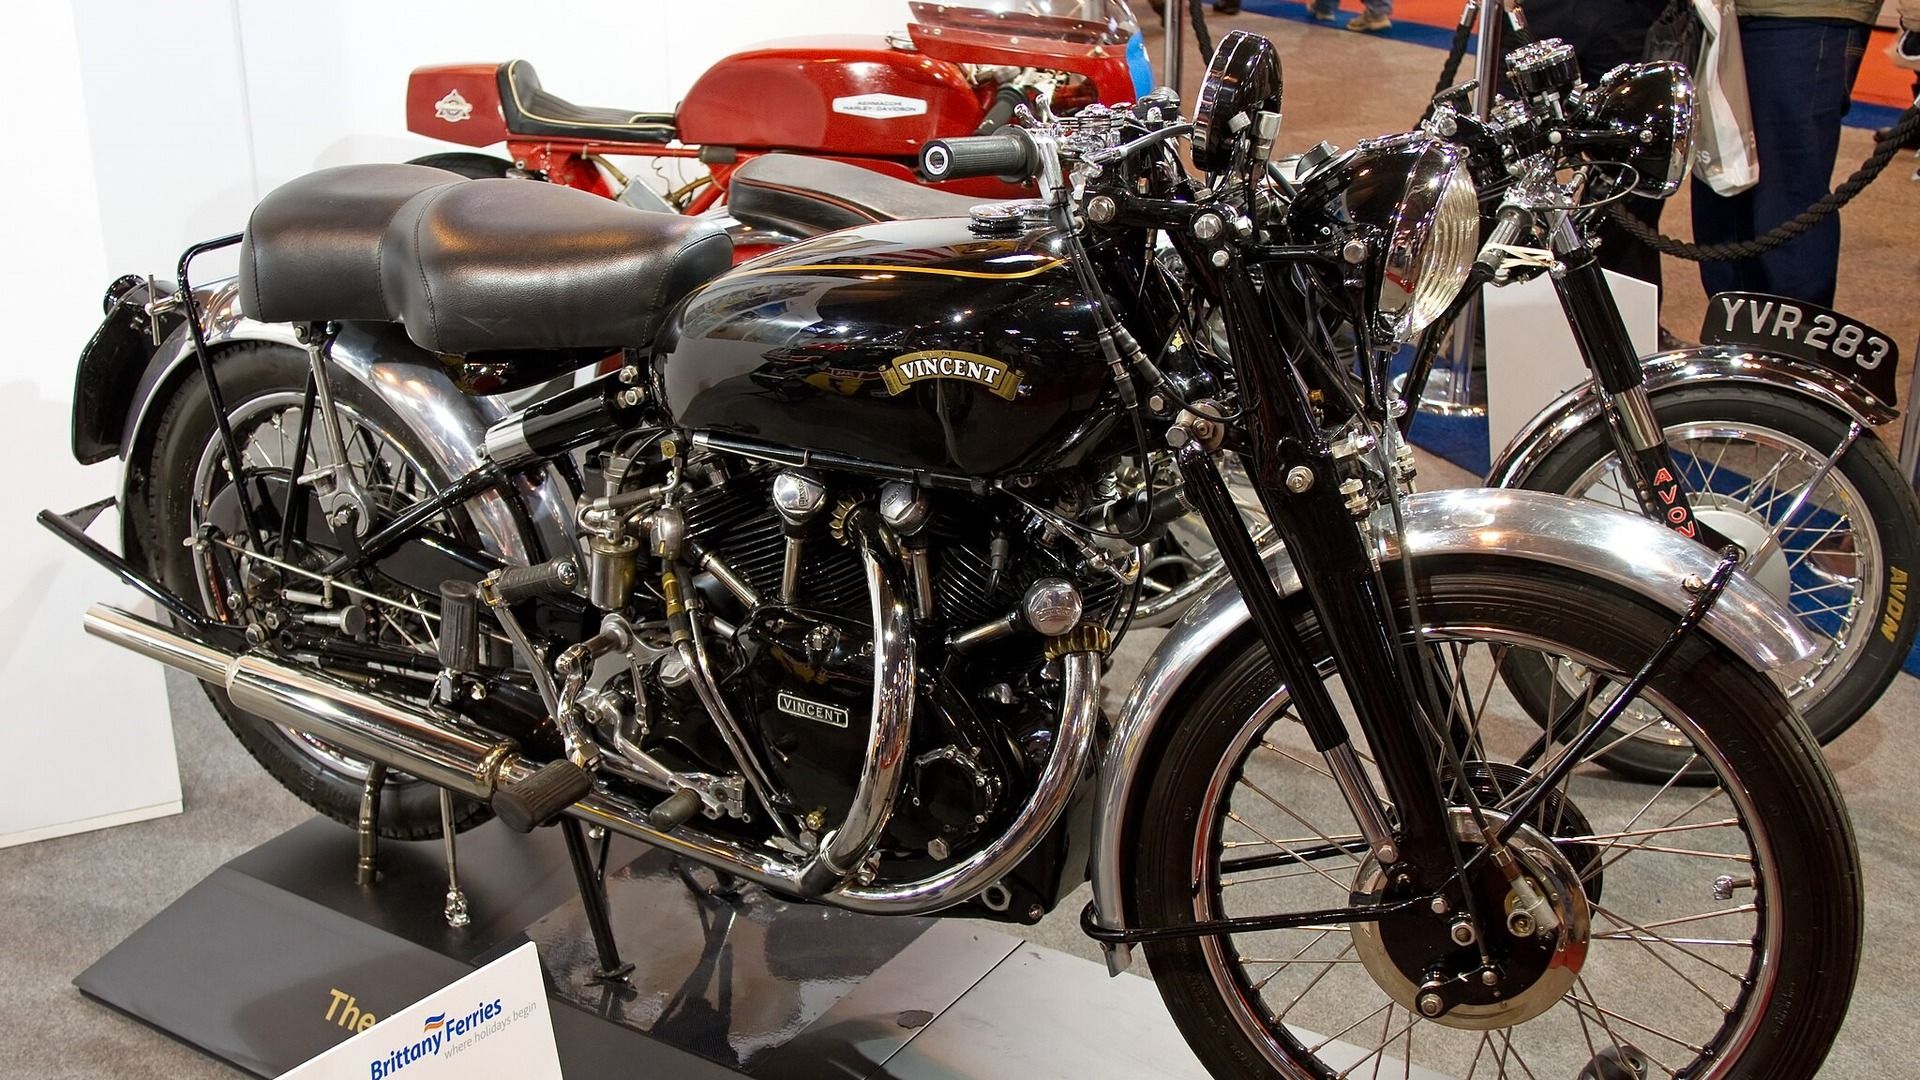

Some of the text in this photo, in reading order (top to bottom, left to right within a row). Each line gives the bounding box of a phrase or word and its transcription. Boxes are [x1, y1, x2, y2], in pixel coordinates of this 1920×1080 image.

[1721, 297, 1890, 371] YVR 283
[900, 357, 1000, 384] VINCENT
[1880, 565, 1909, 643] AVON
[783, 697, 842, 723] VINCENT
[370, 998, 502, 1080] Brittany Ferries
[444, 1001, 537, 1060] where holidays begin
